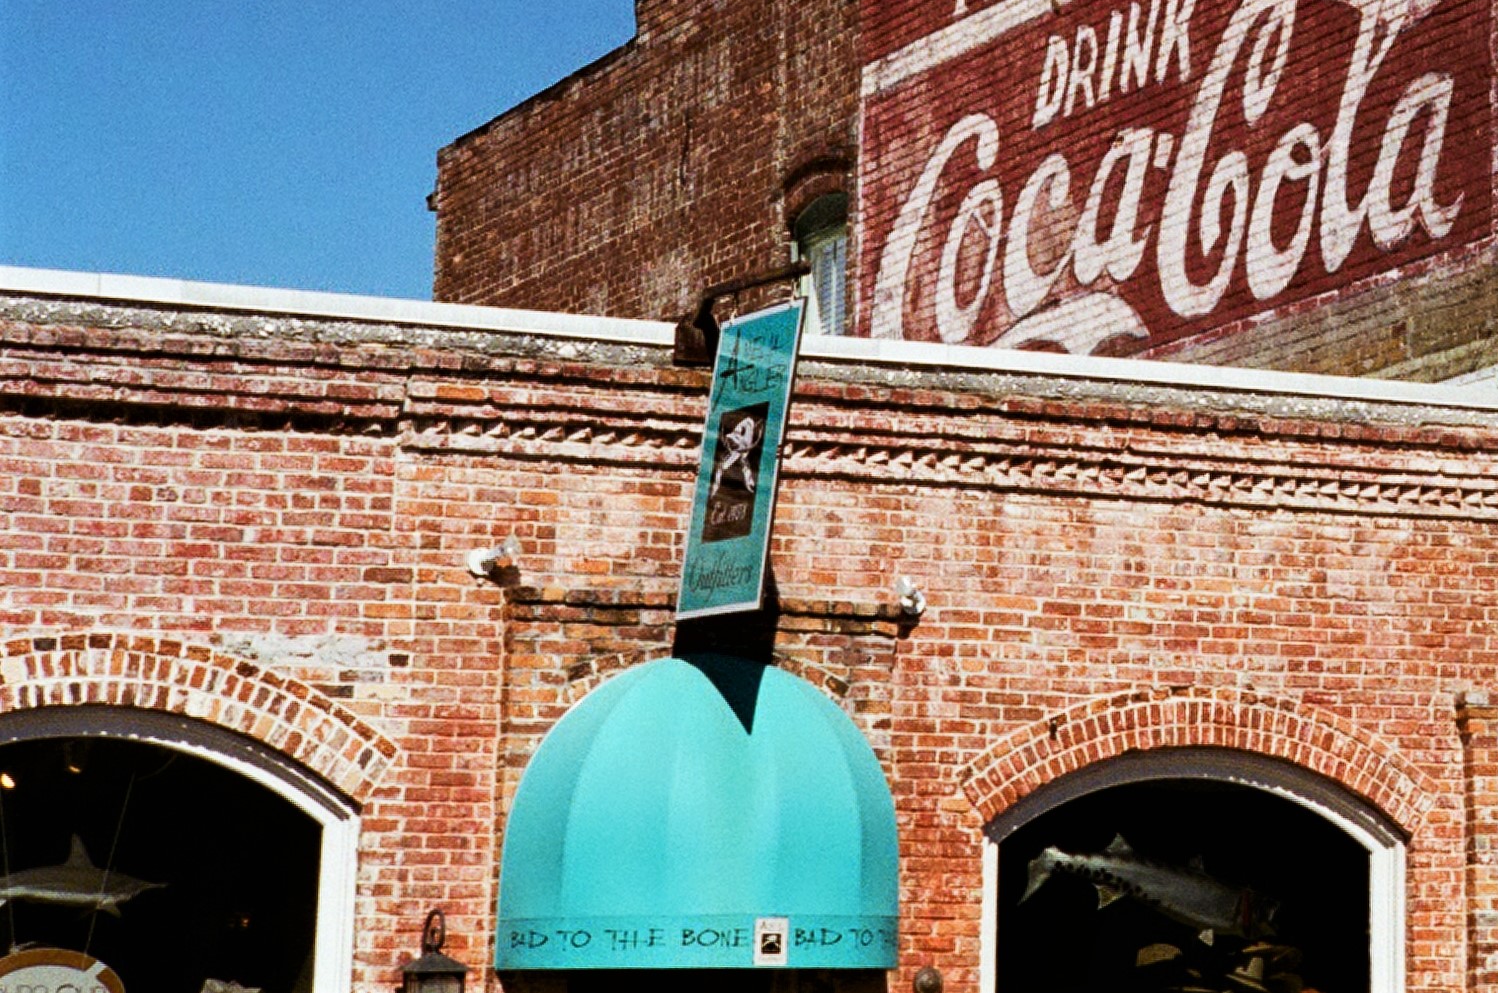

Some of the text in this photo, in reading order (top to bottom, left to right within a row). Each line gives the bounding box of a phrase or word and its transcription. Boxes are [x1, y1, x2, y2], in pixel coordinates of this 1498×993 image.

[556, 929, 592, 952] TO
[603, 928, 666, 951] THE
[681, 928, 749, 948] BONE
[793, 927, 842, 949] BAD
